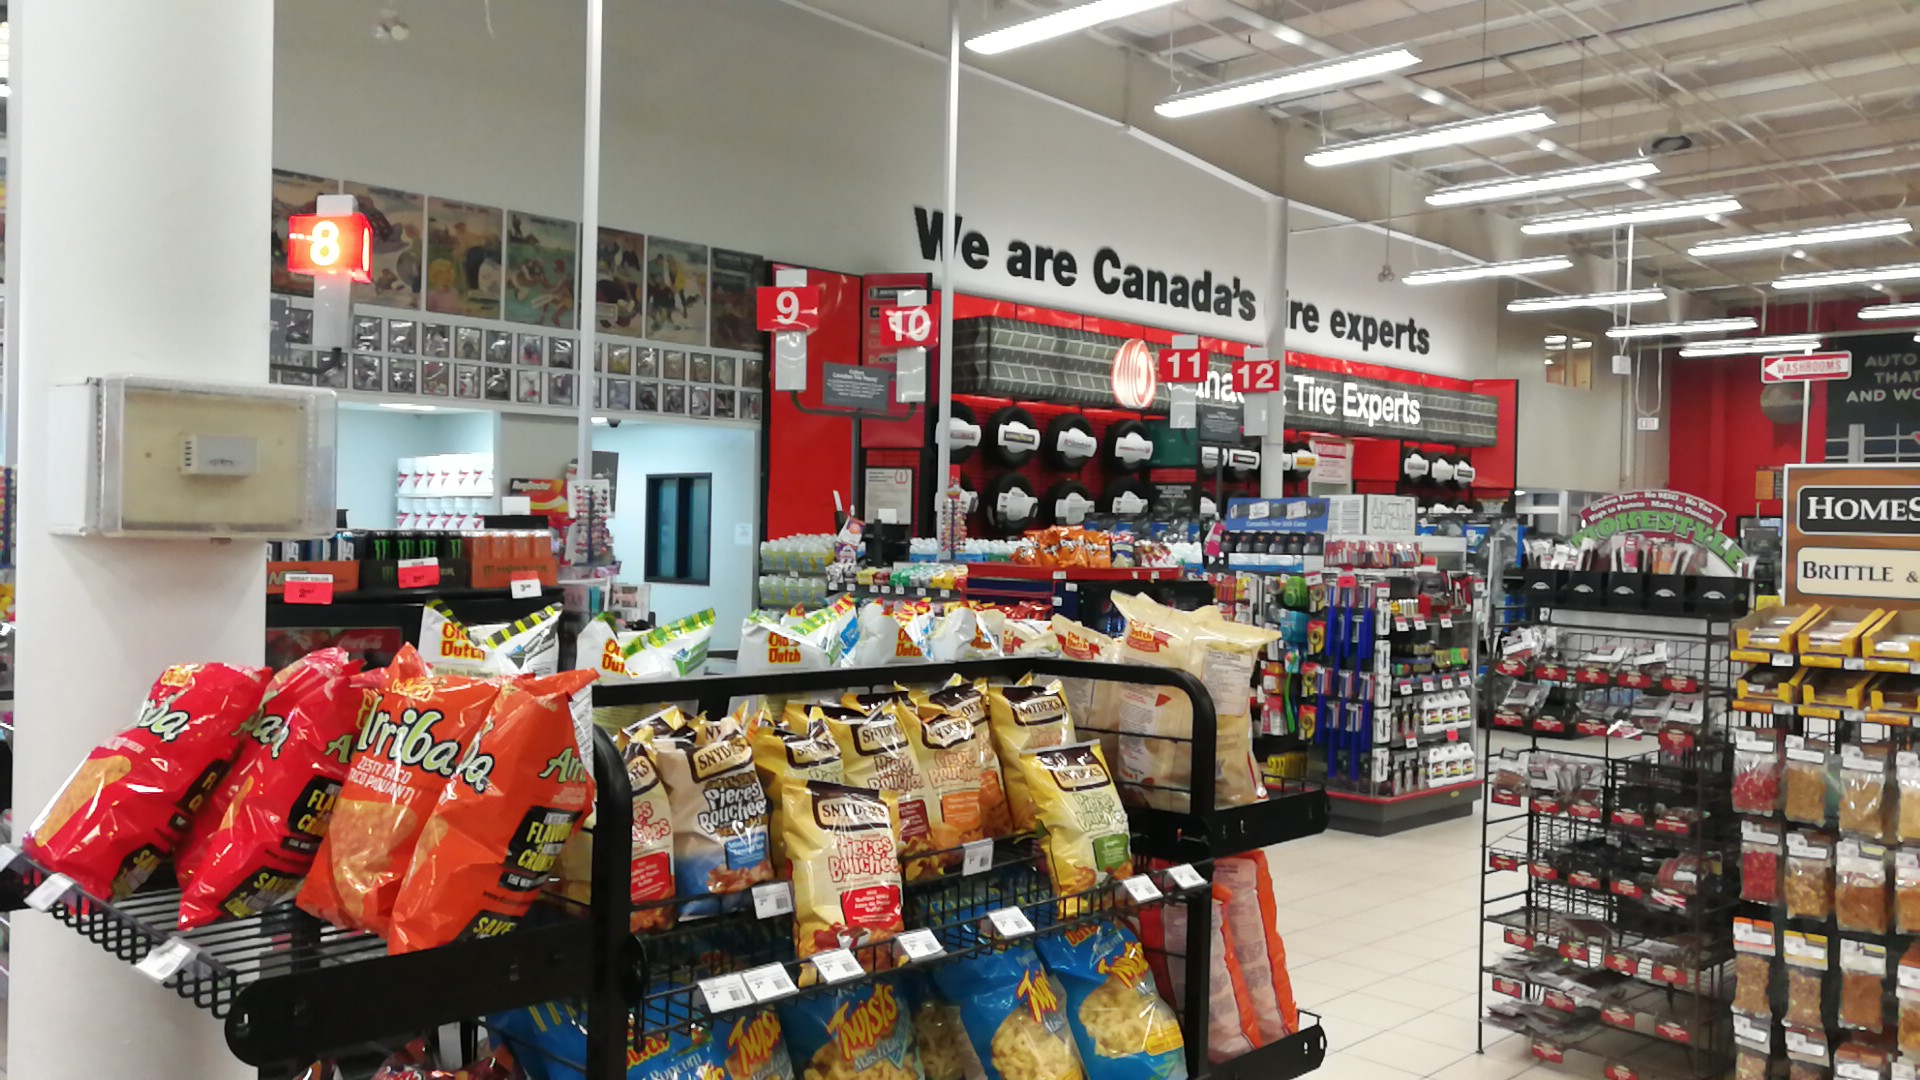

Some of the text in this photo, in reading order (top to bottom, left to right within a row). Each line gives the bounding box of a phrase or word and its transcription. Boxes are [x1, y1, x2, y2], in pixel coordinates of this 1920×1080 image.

[309, 221, 340, 266] 8
[914, 207, 989, 270] We
[1007, 239, 1077, 287] are
[1094, 246, 1256, 321] Canada's
[1330, 308, 1430, 354] experts
[776, 290, 800, 325] 9
[889, 309, 931, 342] 10
[1167, 351, 1201, 379] 11
[1237, 360, 1274, 390] 12
[1777, 360, 1842, 374] WASHROOMS
[1865, 353, 1917, 368] AUTO
[1293, 375, 1336, 415] Tire
[1342, 382, 1421, 427] Experts
[1846, 389, 1887, 403] AND
[1644, 491, 1657, 499] No
[1685, 497, 1698, 507] No
[1651, 500, 1674, 510] Made
[1803, 561, 1919, 583] BRITTLE &
[768, 648, 801, 664] Dutch
[704, 781, 766, 811] Pieces
[826, 983, 899, 1060] Twists
